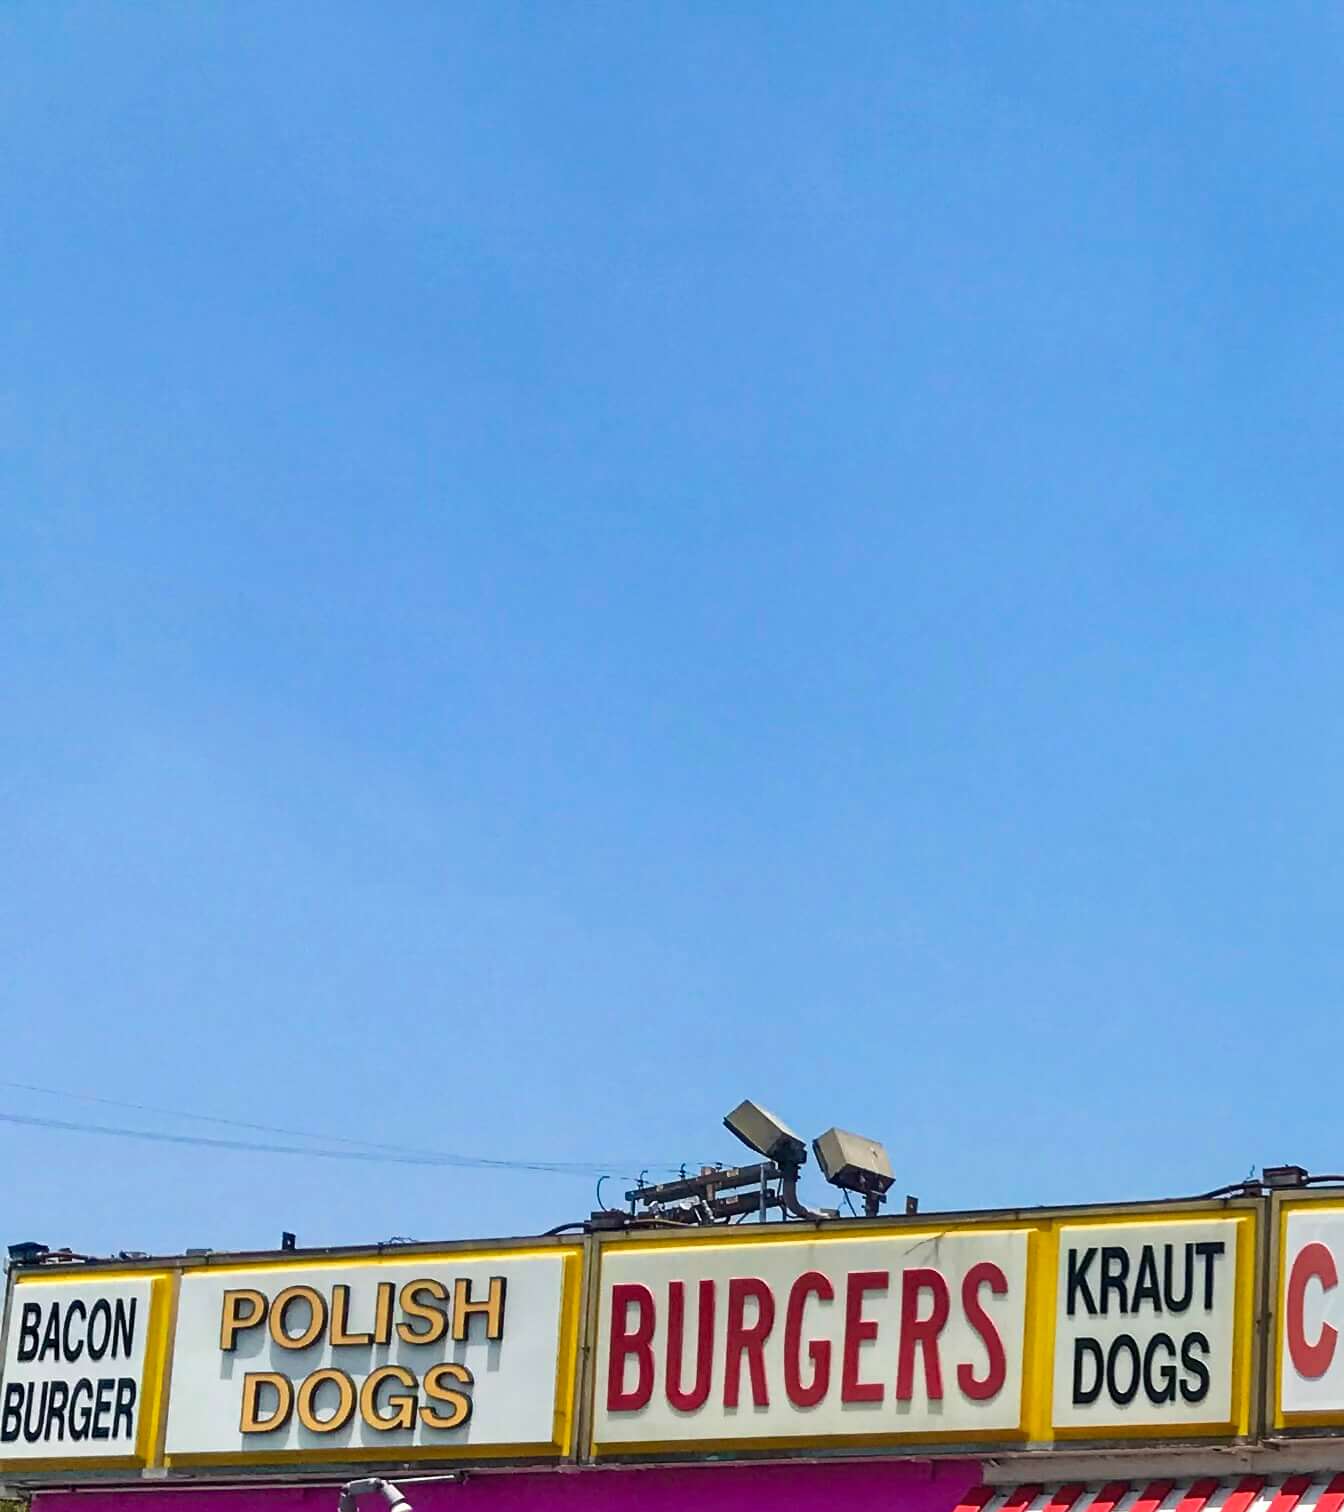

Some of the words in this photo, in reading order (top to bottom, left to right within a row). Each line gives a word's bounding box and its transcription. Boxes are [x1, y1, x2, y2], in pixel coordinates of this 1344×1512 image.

[220, 1276, 506, 1352] POLISH
[1066, 1241, 1225, 1315] KRAUT
[17, 1297, 137, 1364] BACON
[607, 1261, 1009, 1412] BURGERS
[240, 1362, 474, 1435] DOGS
[1072, 1331, 1211, 1405] DOGS
[0, 1377, 137, 1443] BURGER
